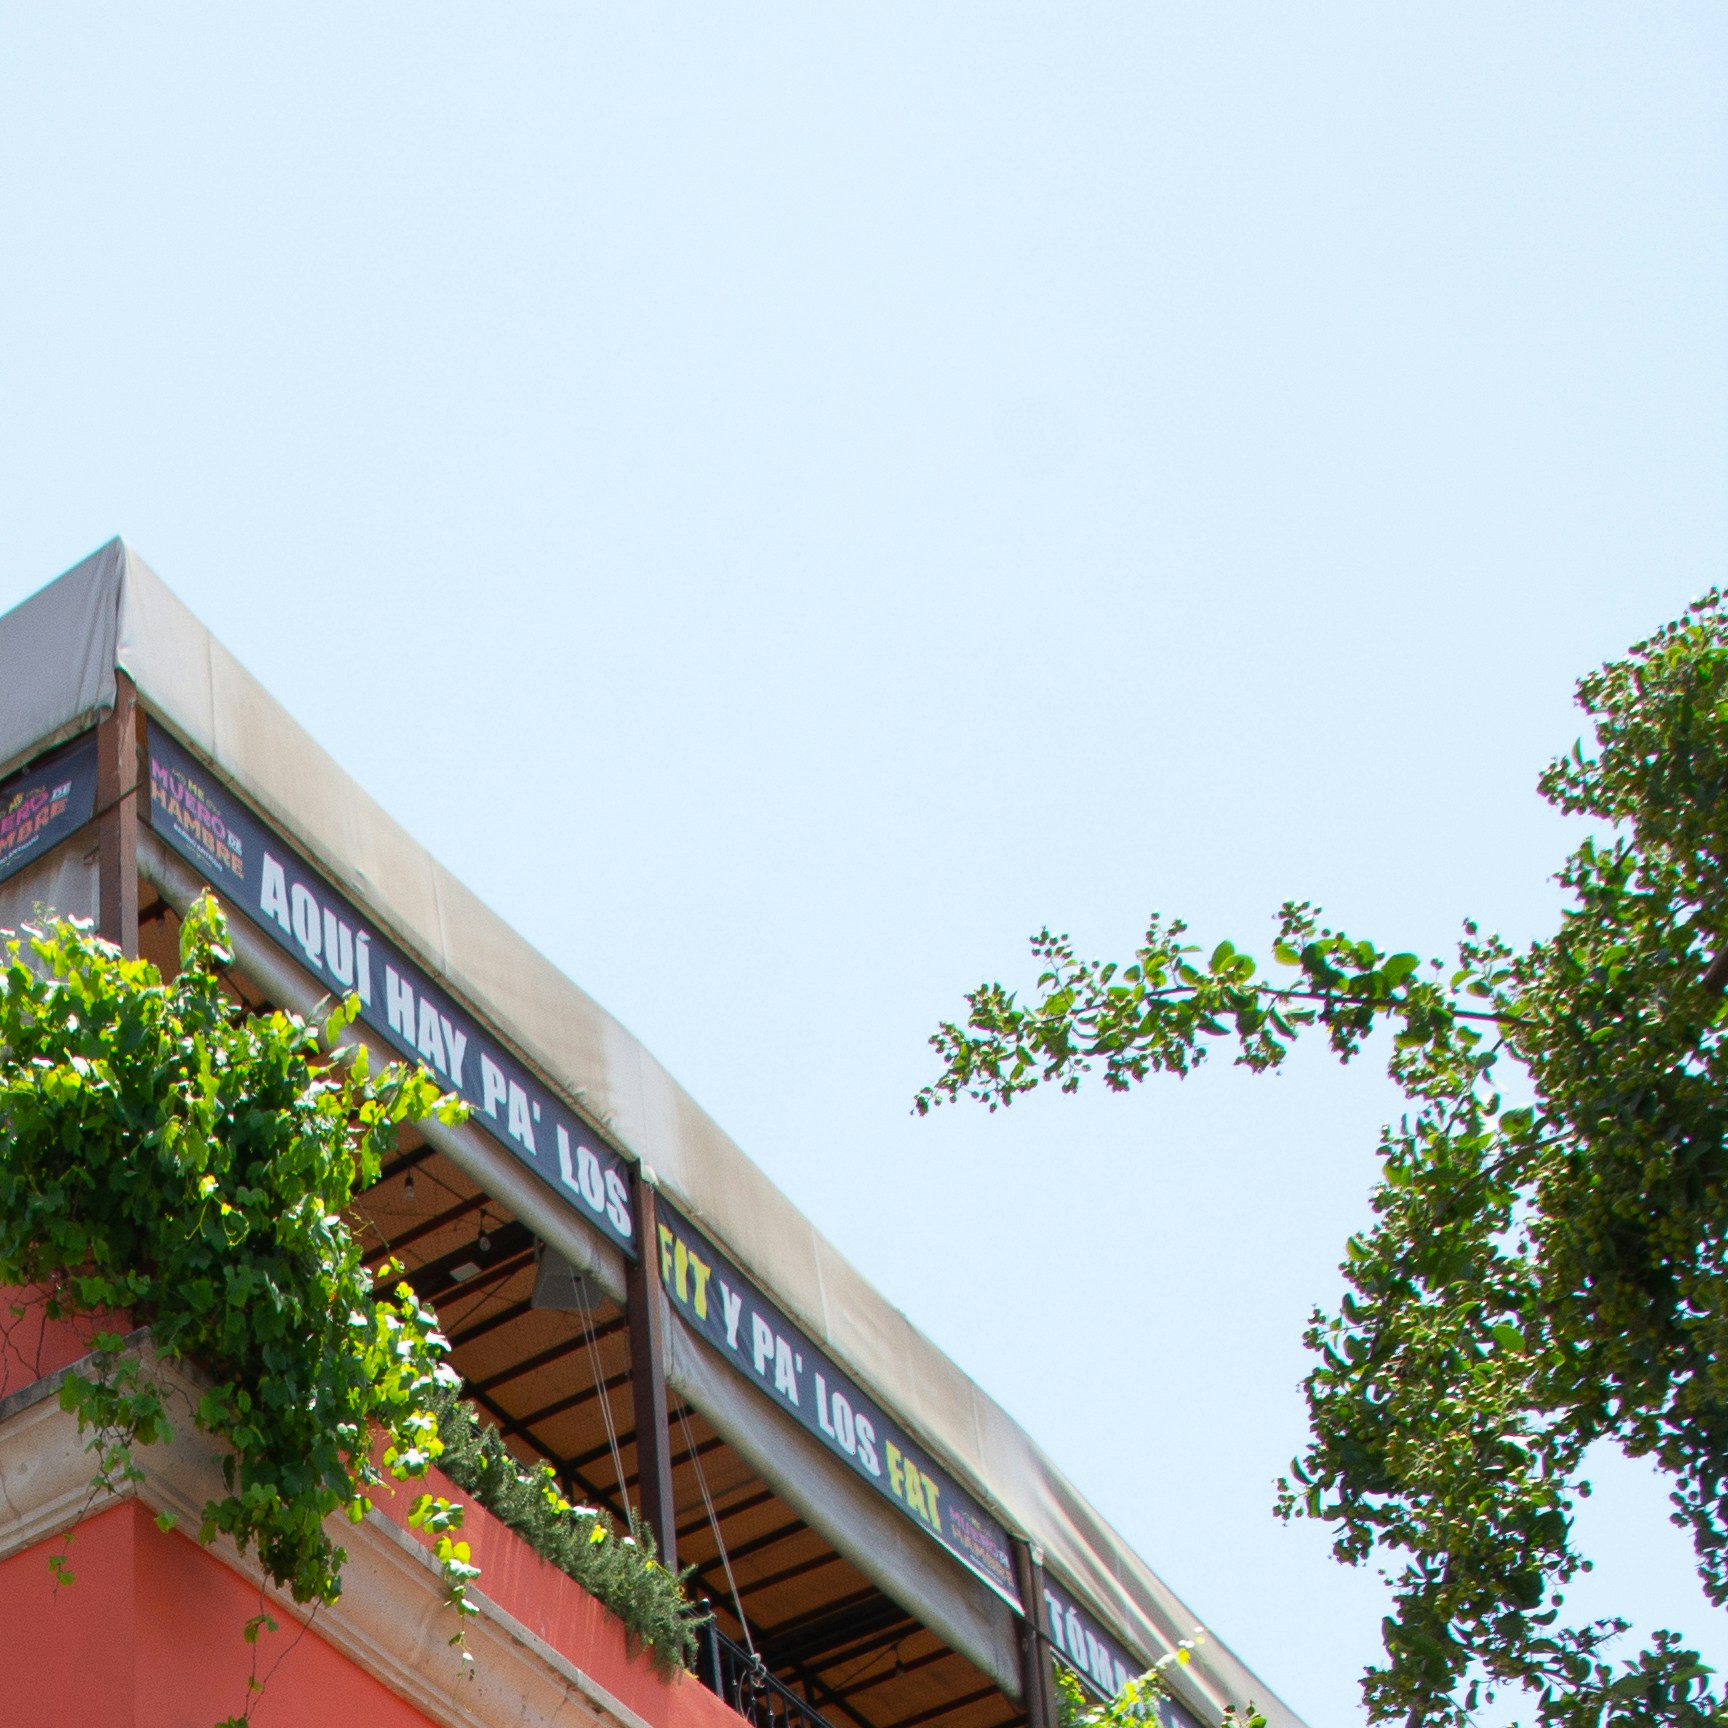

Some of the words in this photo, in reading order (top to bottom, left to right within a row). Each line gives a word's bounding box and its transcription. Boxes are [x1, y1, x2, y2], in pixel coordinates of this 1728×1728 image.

[151, 757, 227, 840] MUERO
[151, 779, 244, 880] HAMBRE
[259, 851, 372, 1008] AQUÍ
[384, 963, 468, 1091] HAY
[480, 1052, 543, 1157] PA'
[555, 1122, 633, 1239] LOS
[657, 1223, 711, 1321] FIT
[719, 1278, 743, 1351] Y
[752, 1310, 803, 1407] PA'
[813, 1370, 882, 1478] LOS
[884, 1438, 942, 1534] FAT
